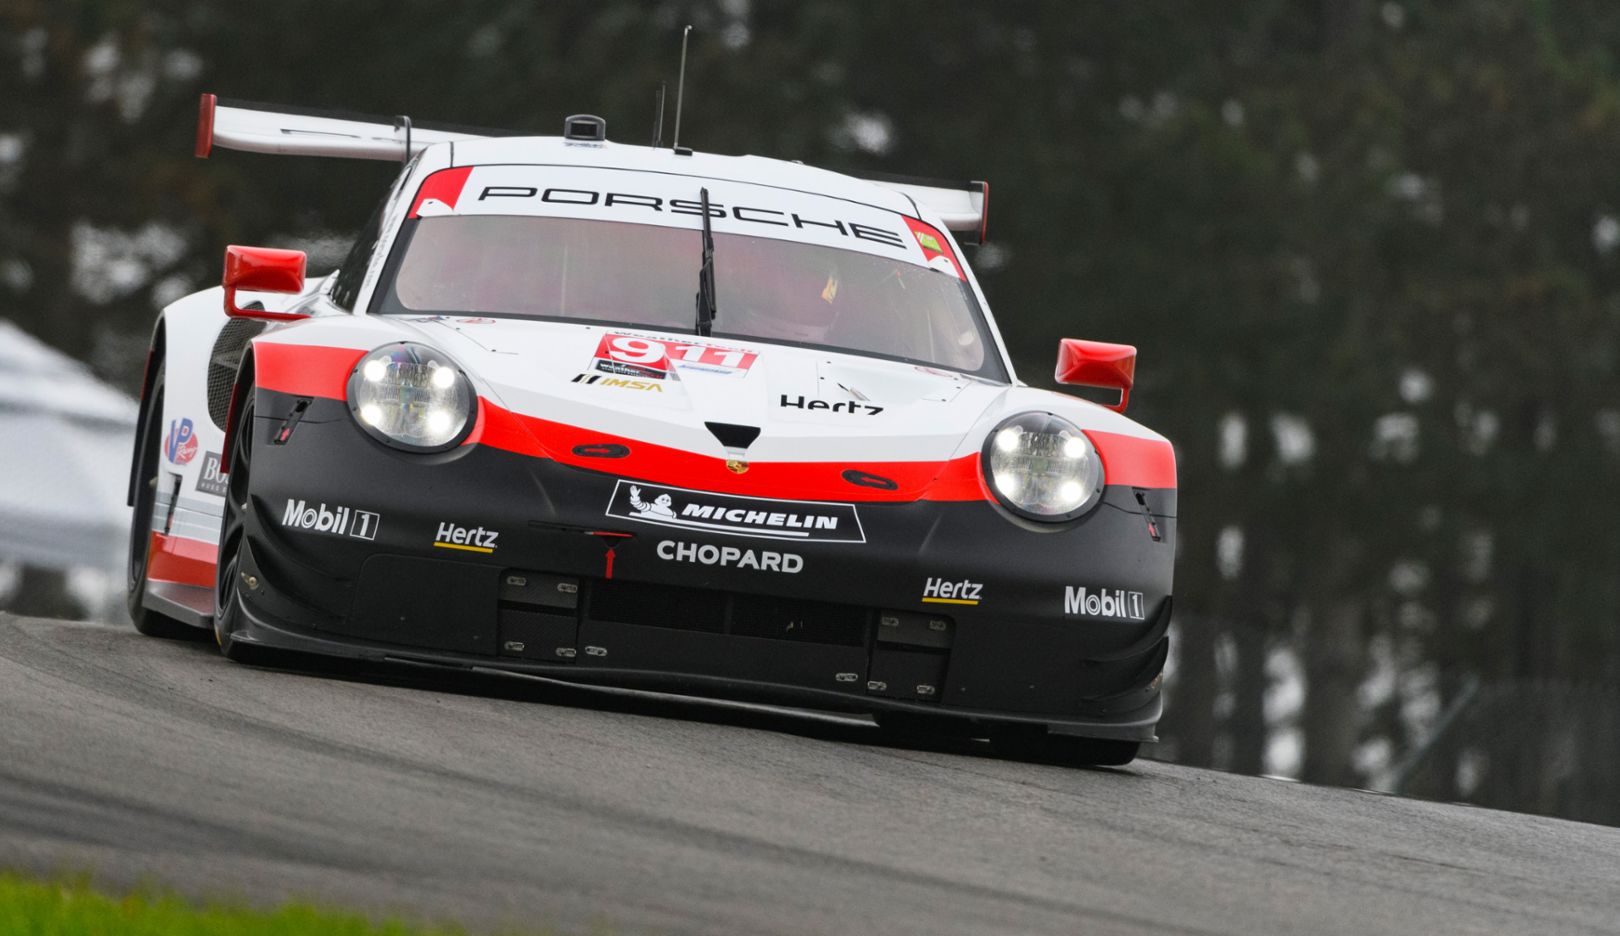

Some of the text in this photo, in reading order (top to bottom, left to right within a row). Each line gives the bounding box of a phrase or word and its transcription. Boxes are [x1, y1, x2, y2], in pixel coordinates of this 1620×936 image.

[478, 186, 907, 250] PORSCHE
[609, 337, 746, 367] 911
[780, 394, 885, 416] Hertz
[282, 499, 349, 535] Mobil
[681, 503, 838, 530] MICHELIN
[434, 522, 497, 548] Hertz
[657, 540, 804, 574] CHOPARD
[923, 577, 983, 600] Hertz
[1064, 586, 1126, 618] Mobil
